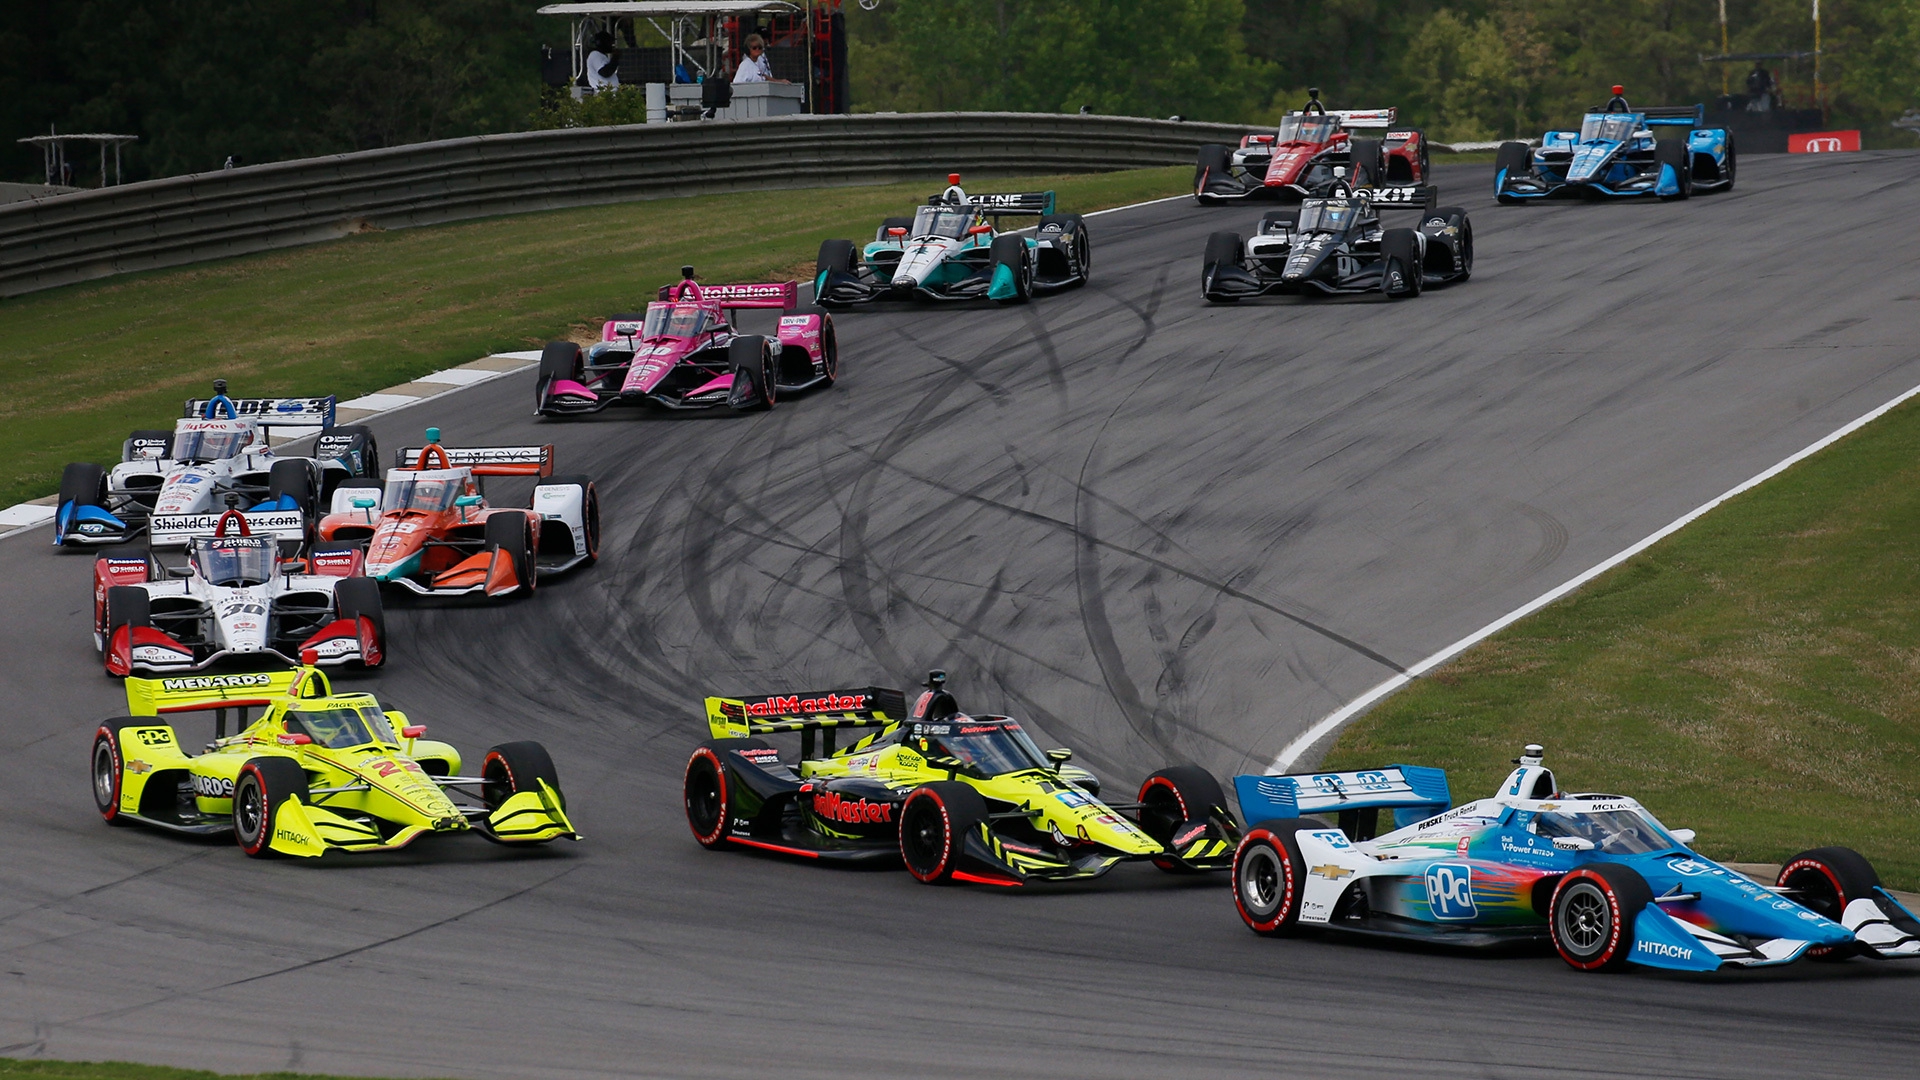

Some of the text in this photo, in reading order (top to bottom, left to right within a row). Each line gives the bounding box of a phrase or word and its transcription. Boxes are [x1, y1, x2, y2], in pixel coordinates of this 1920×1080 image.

[684, 285, 780, 299] AtoNation
[222, 603, 266, 619] 30
[164, 675, 271, 690] MENARDS
[746, 694, 866, 716] ealMaster
[139, 730, 170, 745] PPG
[372, 760, 424, 778] 22
[1509, 768, 1528, 796] 3
[1418, 803, 1478, 831] PENSKE Truck Rental
[1502, 843, 1531, 853] V-Power
[1779, 860, 1822, 885] Firestone
[1428, 868, 1469, 913] PPG
[1638, 940, 1693, 960] HITACHI
